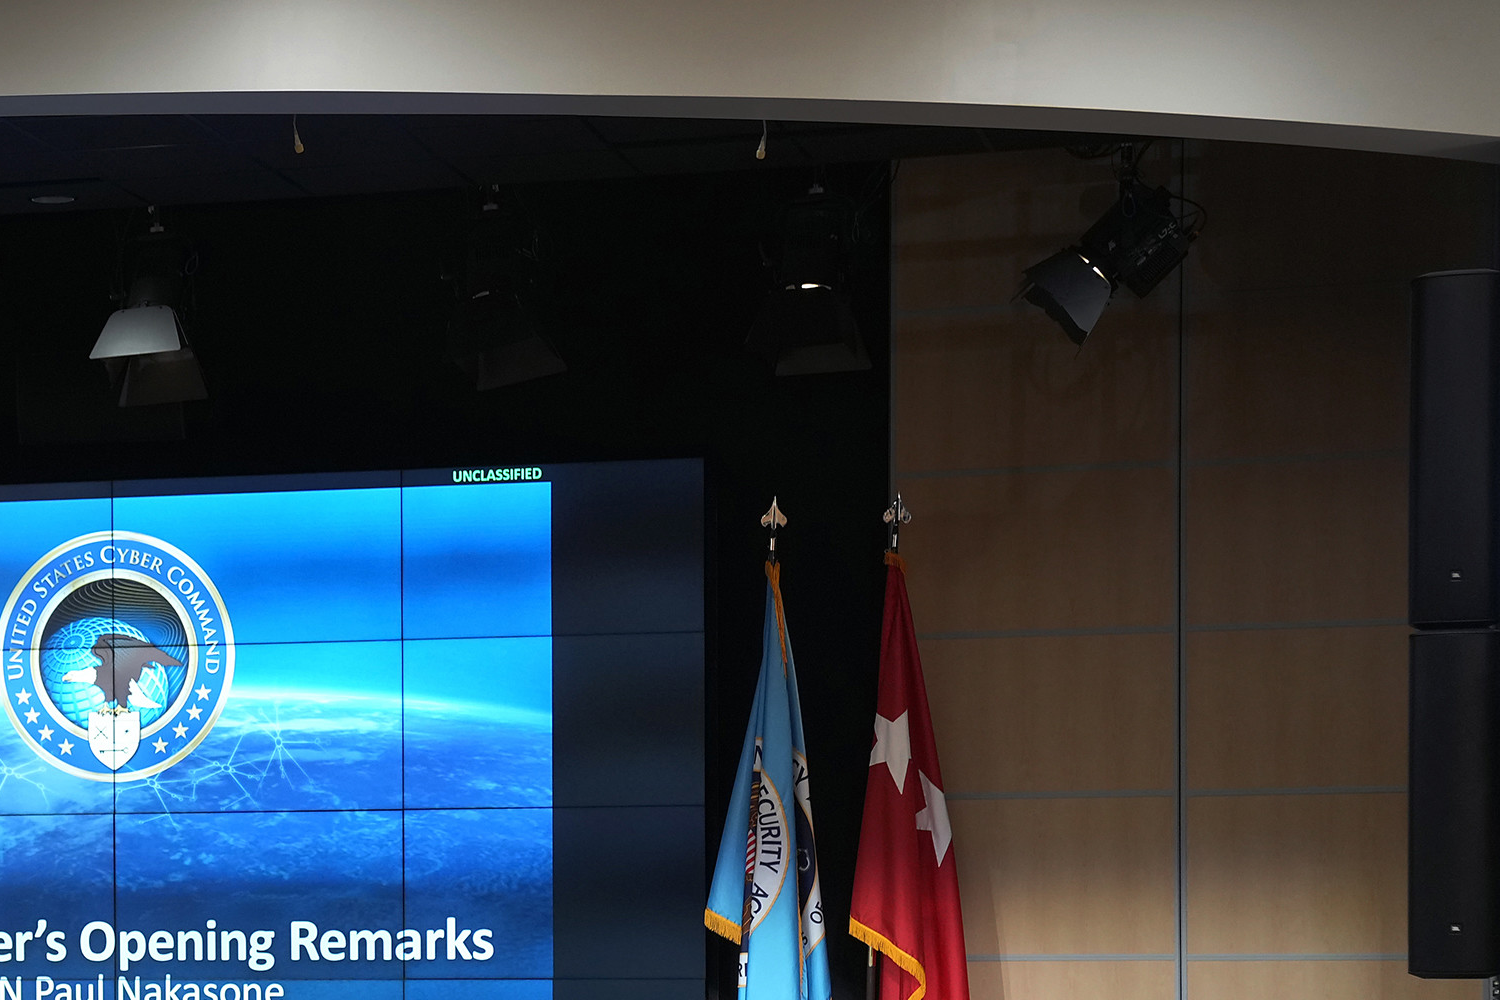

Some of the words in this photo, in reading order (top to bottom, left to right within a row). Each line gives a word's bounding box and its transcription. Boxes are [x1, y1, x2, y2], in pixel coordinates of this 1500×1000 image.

[452, 467, 543, 482] UNCLASSIFIED
[7, 599, 37, 681] UNITED
[33, 550, 94, 599] STATES
[99, 545, 164, 574] CYBER
[166, 565, 220, 675] COMMAND
[757, 780, 782, 874] ECURITY
[79, 919, 276, 972] Opening
[290, 916, 495, 962] Remarks
